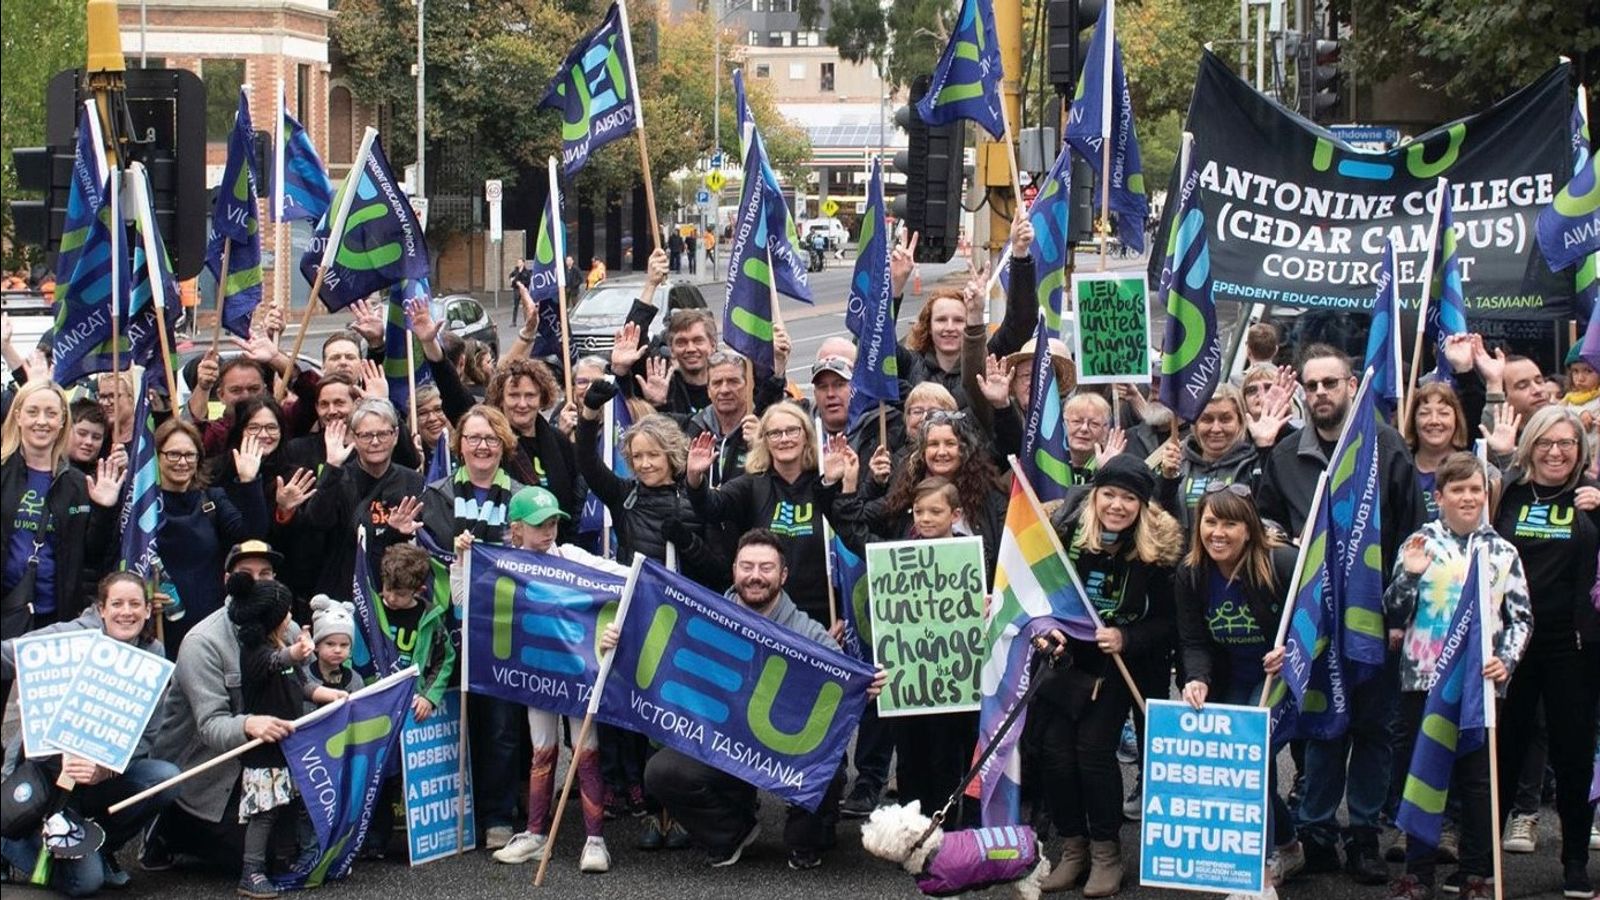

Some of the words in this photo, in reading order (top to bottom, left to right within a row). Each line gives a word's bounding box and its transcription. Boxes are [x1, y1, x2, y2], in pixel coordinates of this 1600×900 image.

[1200, 160, 1396, 220] ANTONINE
[401, 223, 417, 257] UNION
[1216, 203, 1352, 254] (CEDAR
[1399, 257, 1475, 284] EAT
[1090, 281, 1118, 297] IEU
[1282, 287, 1359, 308] EDUCATION
[1475, 295, 1544, 309] TASMANIA
[1080, 293, 1145, 315] members
[773, 501, 812, 524] IEU
[1518, 504, 1574, 525] IEU
[496, 558, 576, 585] INDEPENDENT
[890, 546, 935, 571] IEU
[872, 562, 982, 597] members
[875, 590, 980, 625] united
[664, 585, 741, 632] INDEPENDENT
[741, 626, 809, 663] EDUCATION
[810, 659, 852, 682] UNION
[925, 626, 935, 640] to
[91, 641, 163, 688] OUR
[936, 663, 951, 676] the
[83, 666, 153, 701] STUDENTS
[492, 665, 569, 698] VICTORIA
[635, 603, 844, 756] IEU
[1329, 672, 1345, 714] UNION
[77, 680, 145, 716] DESERVE
[68, 697, 79, 709] A
[82, 700, 138, 733] BETTER
[1180, 712, 1231, 735] OUR
[60, 710, 132, 749] FUTURE
[406, 720, 461, 745] STUDENT
[630, 690, 705, 745] VICTORIA
[710, 730, 805, 791] TASMANIA
[407, 742, 461, 770] DESERV
[1151, 737, 1261, 762] STUDENTS
[1151, 762, 1260, 790] DESERVE
[408, 783, 419, 801] A
[1146, 796, 1164, 815] A
[1170, 797, 1261, 824] BETTER
[416, 832, 439, 854] IEU
[1146, 822, 1261, 855] FUTURE
[1152, 856, 1194, 878] IEU
